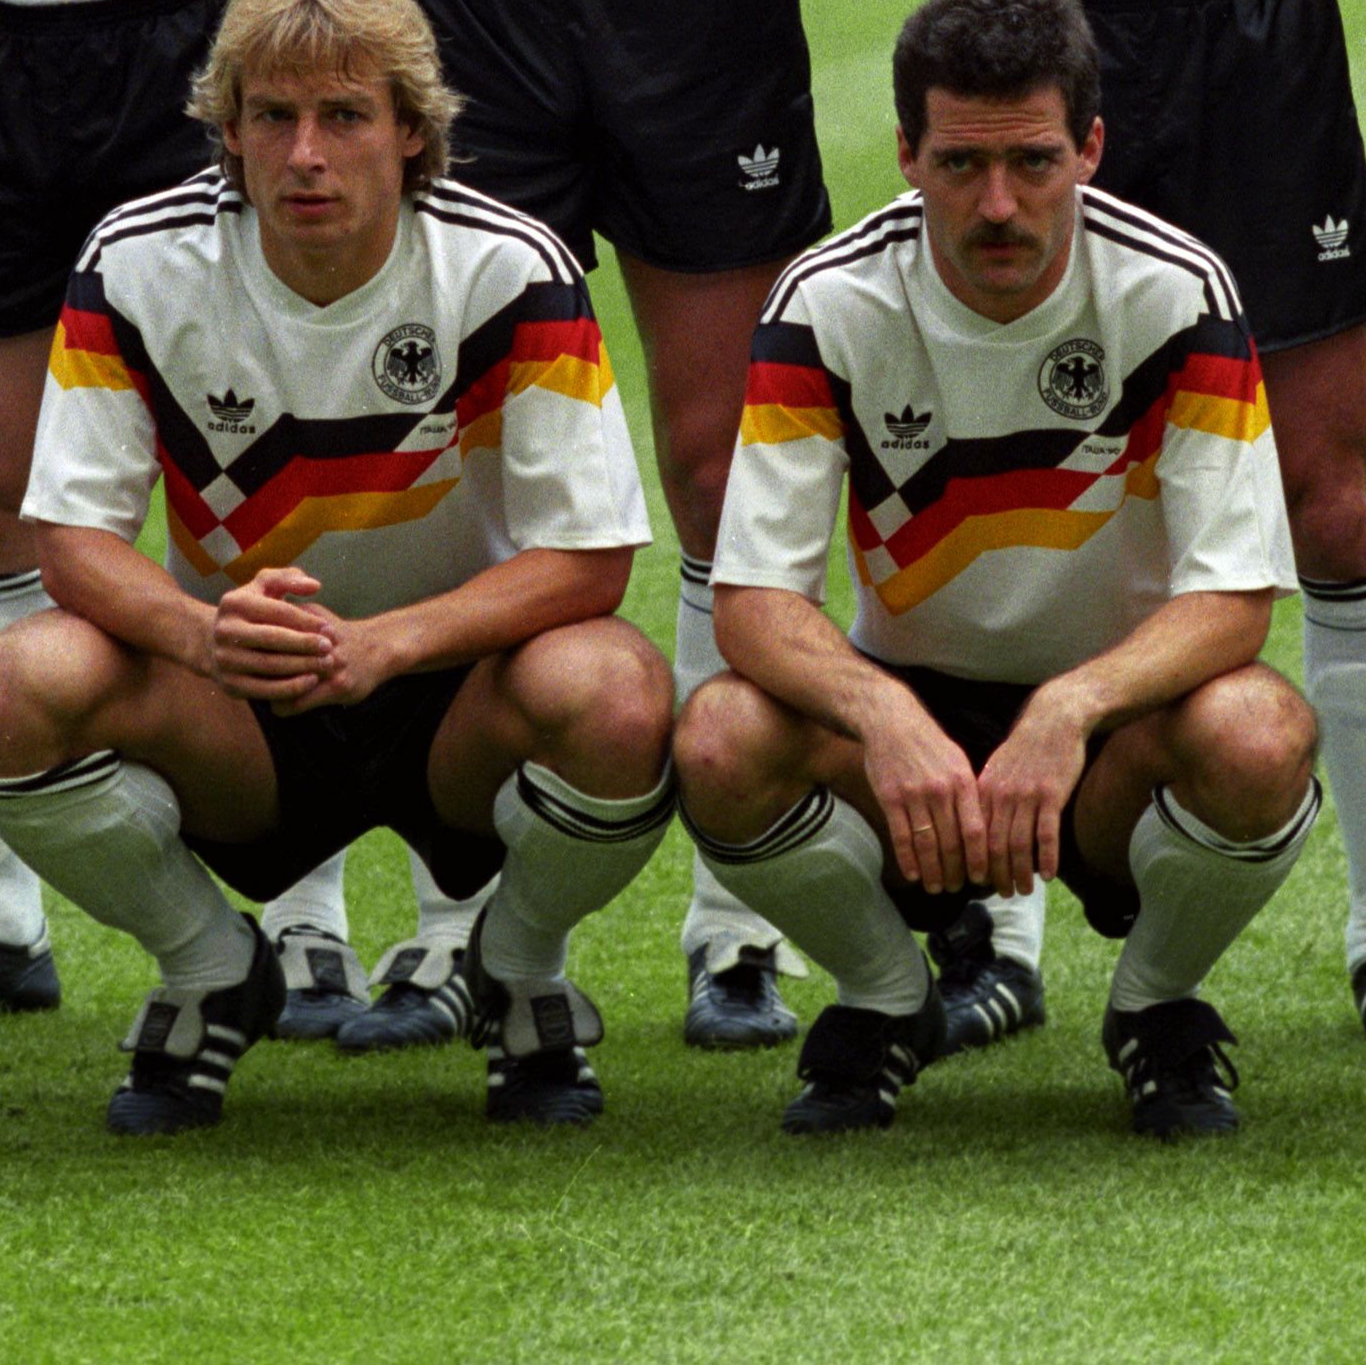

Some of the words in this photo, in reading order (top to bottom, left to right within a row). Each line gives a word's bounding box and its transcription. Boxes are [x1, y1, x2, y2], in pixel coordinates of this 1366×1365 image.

[1317, 246, 1351, 262] adidas
[207, 421, 256, 435] adidas
[881, 438, 930, 450] adidas
